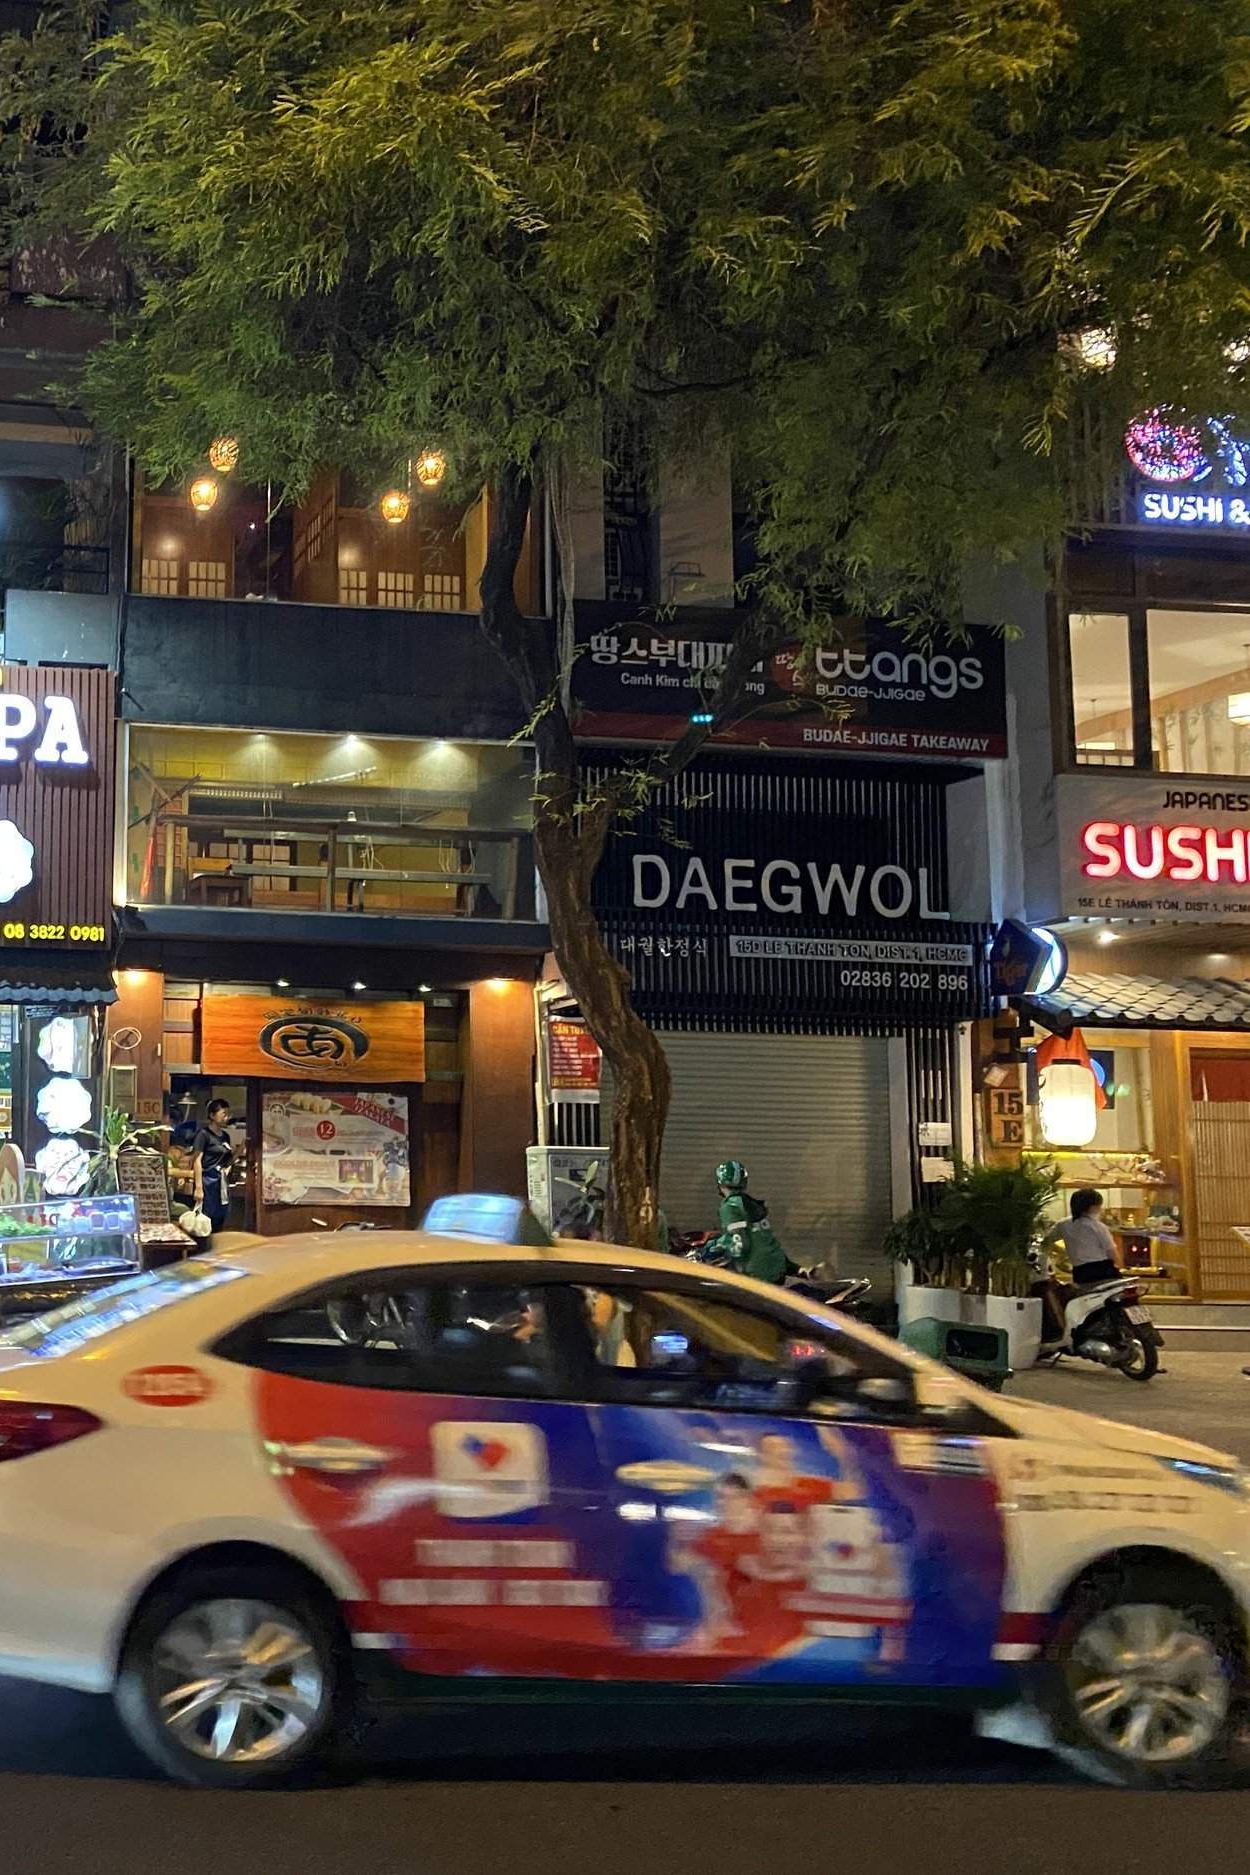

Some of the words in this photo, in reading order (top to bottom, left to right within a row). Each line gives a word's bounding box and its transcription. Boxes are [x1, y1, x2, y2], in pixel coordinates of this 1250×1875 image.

[1144, 493, 1224, 523] SUSHI
[621, 672, 652, 686] Canh
[656, 674, 680, 688] Kim
[816, 647, 984, 699] ttangs
[803, 728, 907, 749] BUDAE-JJIGAE
[911, 733, 989, 752] TAKEAWAY
[1083, 821, 1250, 883] SUSH
[632, 853, 949, 920] DAEGWOL
[1078, 898, 1095, 908] 15E
[1099, 896, 1112, 909] LÊ
[1115, 897, 1152, 910] THÁNH
[4, 924, 25, 939] 08
[30, 925, 65, 940] 3822
[70, 925, 105, 942] 0981
[620, 935, 708, 957] 대궐한정식
[736, 940, 761, 953] 15D
[765, 941, 783, 954] LE
[786, 942, 836, 956] THANH
[839, 944, 873, 960] TON,
[926, 947, 968, 962] HCMC
[841, 970, 891, 987] 02836
[900, 972, 930, 988] 202
[938, 974, 968, 991] 896
[137, 1101, 161, 1114] 15C
[994, 1092, 1023, 1115] 15
[320, 1123, 333, 1134] 12
[1000, 1119, 1023, 1143] E
